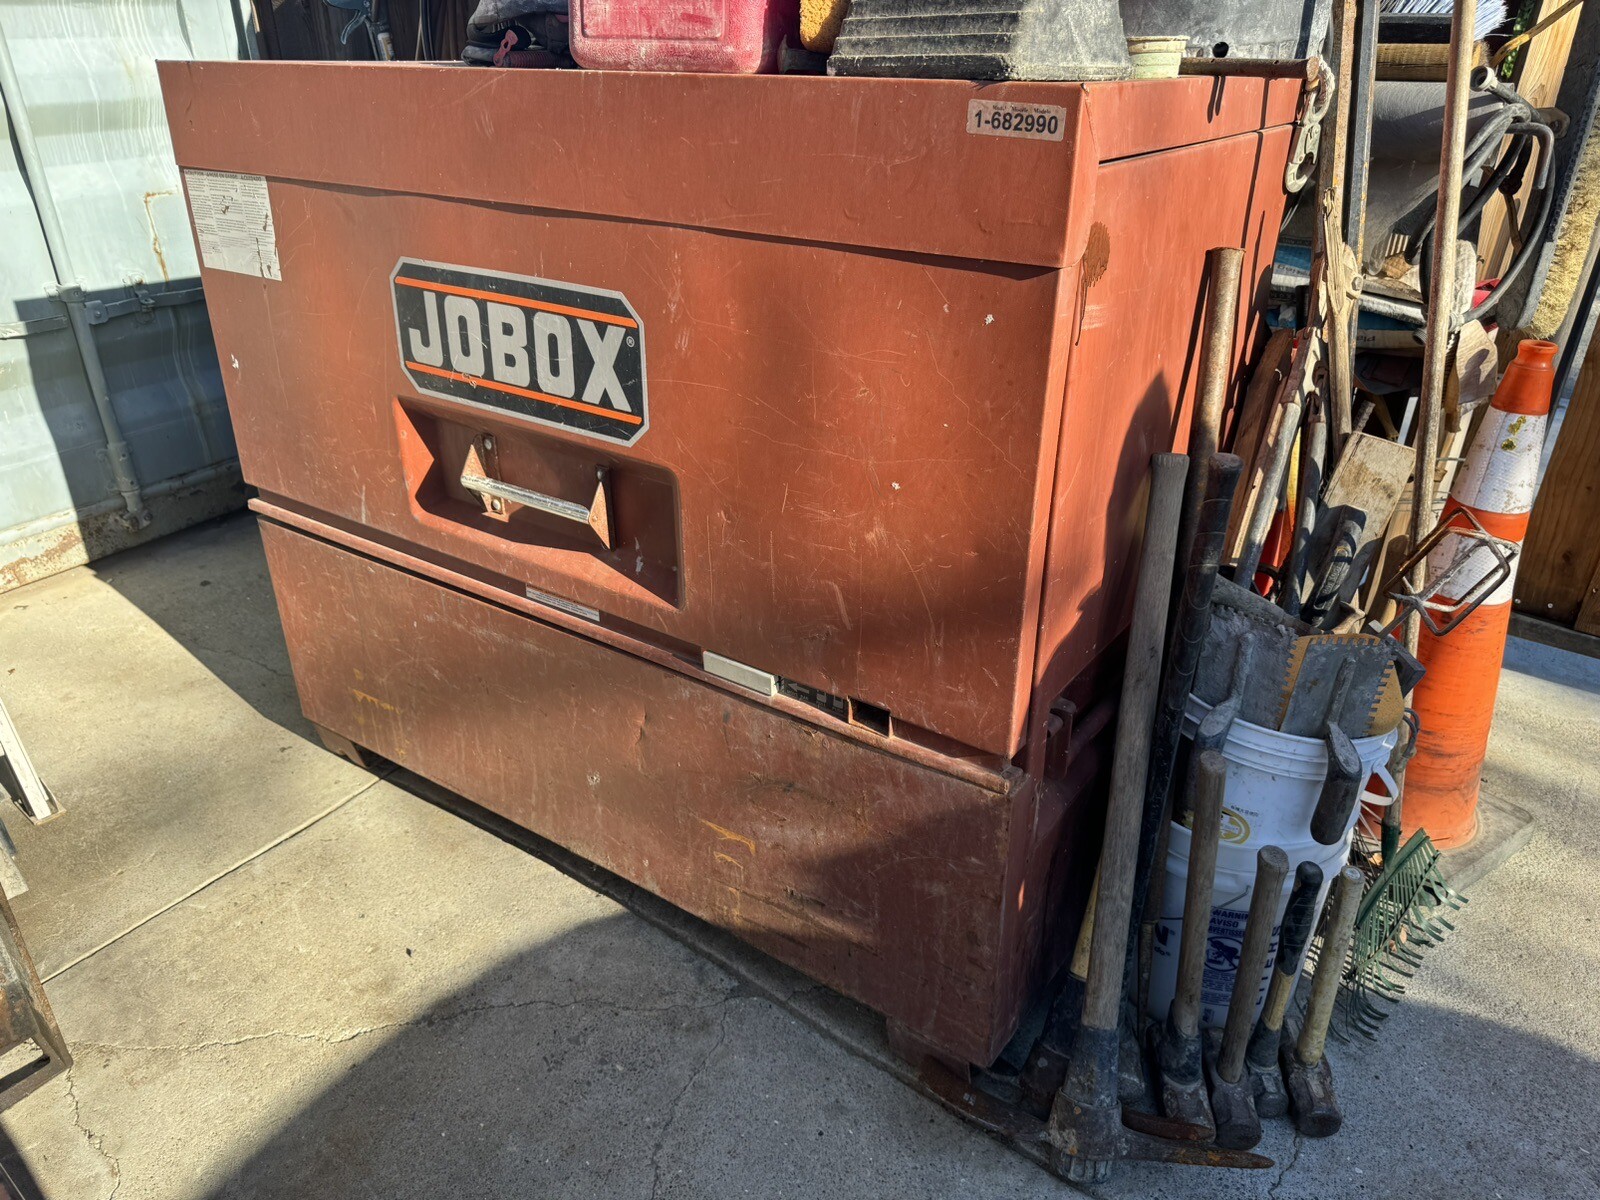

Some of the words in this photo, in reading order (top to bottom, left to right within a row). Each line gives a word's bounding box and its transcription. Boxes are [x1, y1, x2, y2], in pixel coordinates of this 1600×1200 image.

[975, 109, 1058, 135] 1-682990
[408, 291, 632, 413] JOBOX
[1212, 909, 1249, 920] WARNIN
[1209, 917, 1239, 928] AVISO
[1208, 925, 1245, 937] AVERTISSE
